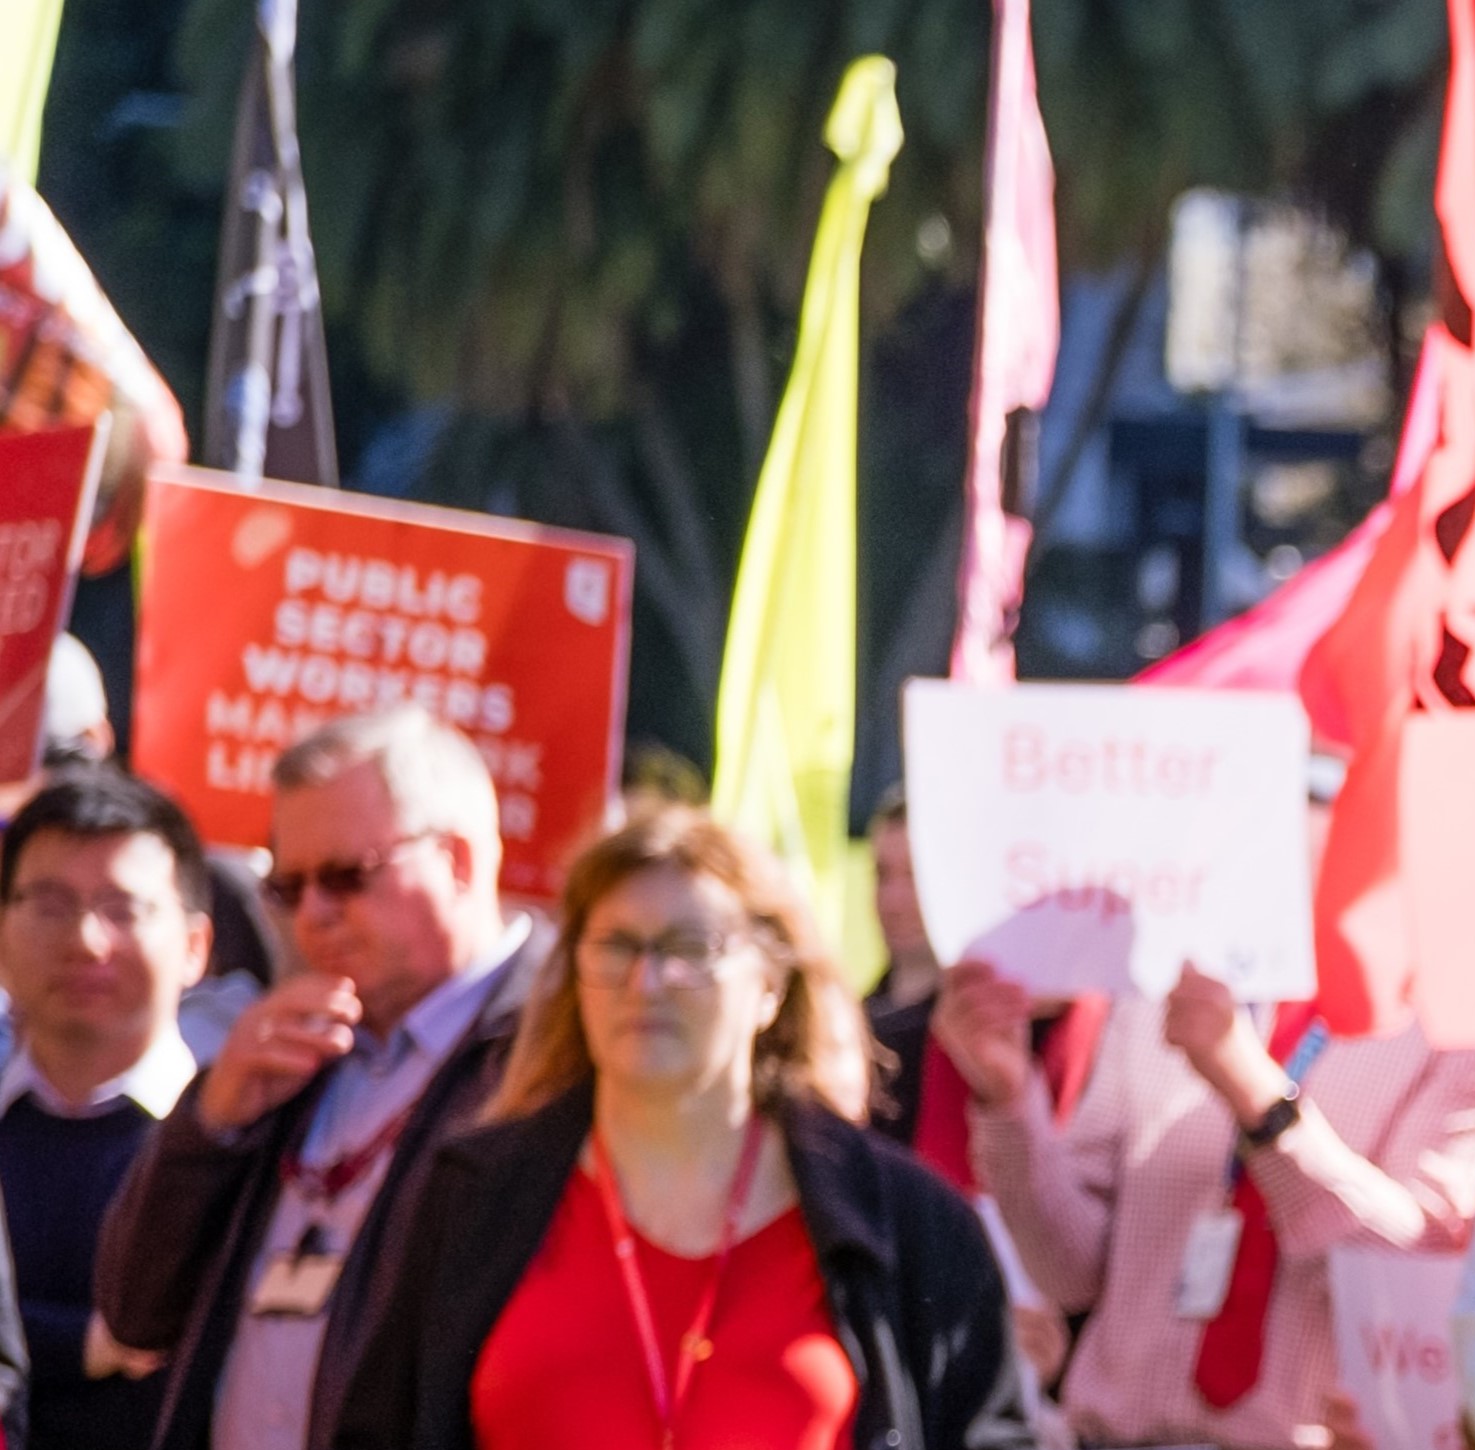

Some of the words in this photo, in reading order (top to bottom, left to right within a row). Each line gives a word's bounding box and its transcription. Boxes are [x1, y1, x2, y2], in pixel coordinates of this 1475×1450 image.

[285, 547, 484, 624] PUBLIC
[274, 598, 488, 677] SECTOR
[241, 642, 514, 732] WORKERS
[1002, 723, 1220, 797] Better
[1006, 841, 1207, 924] Super
